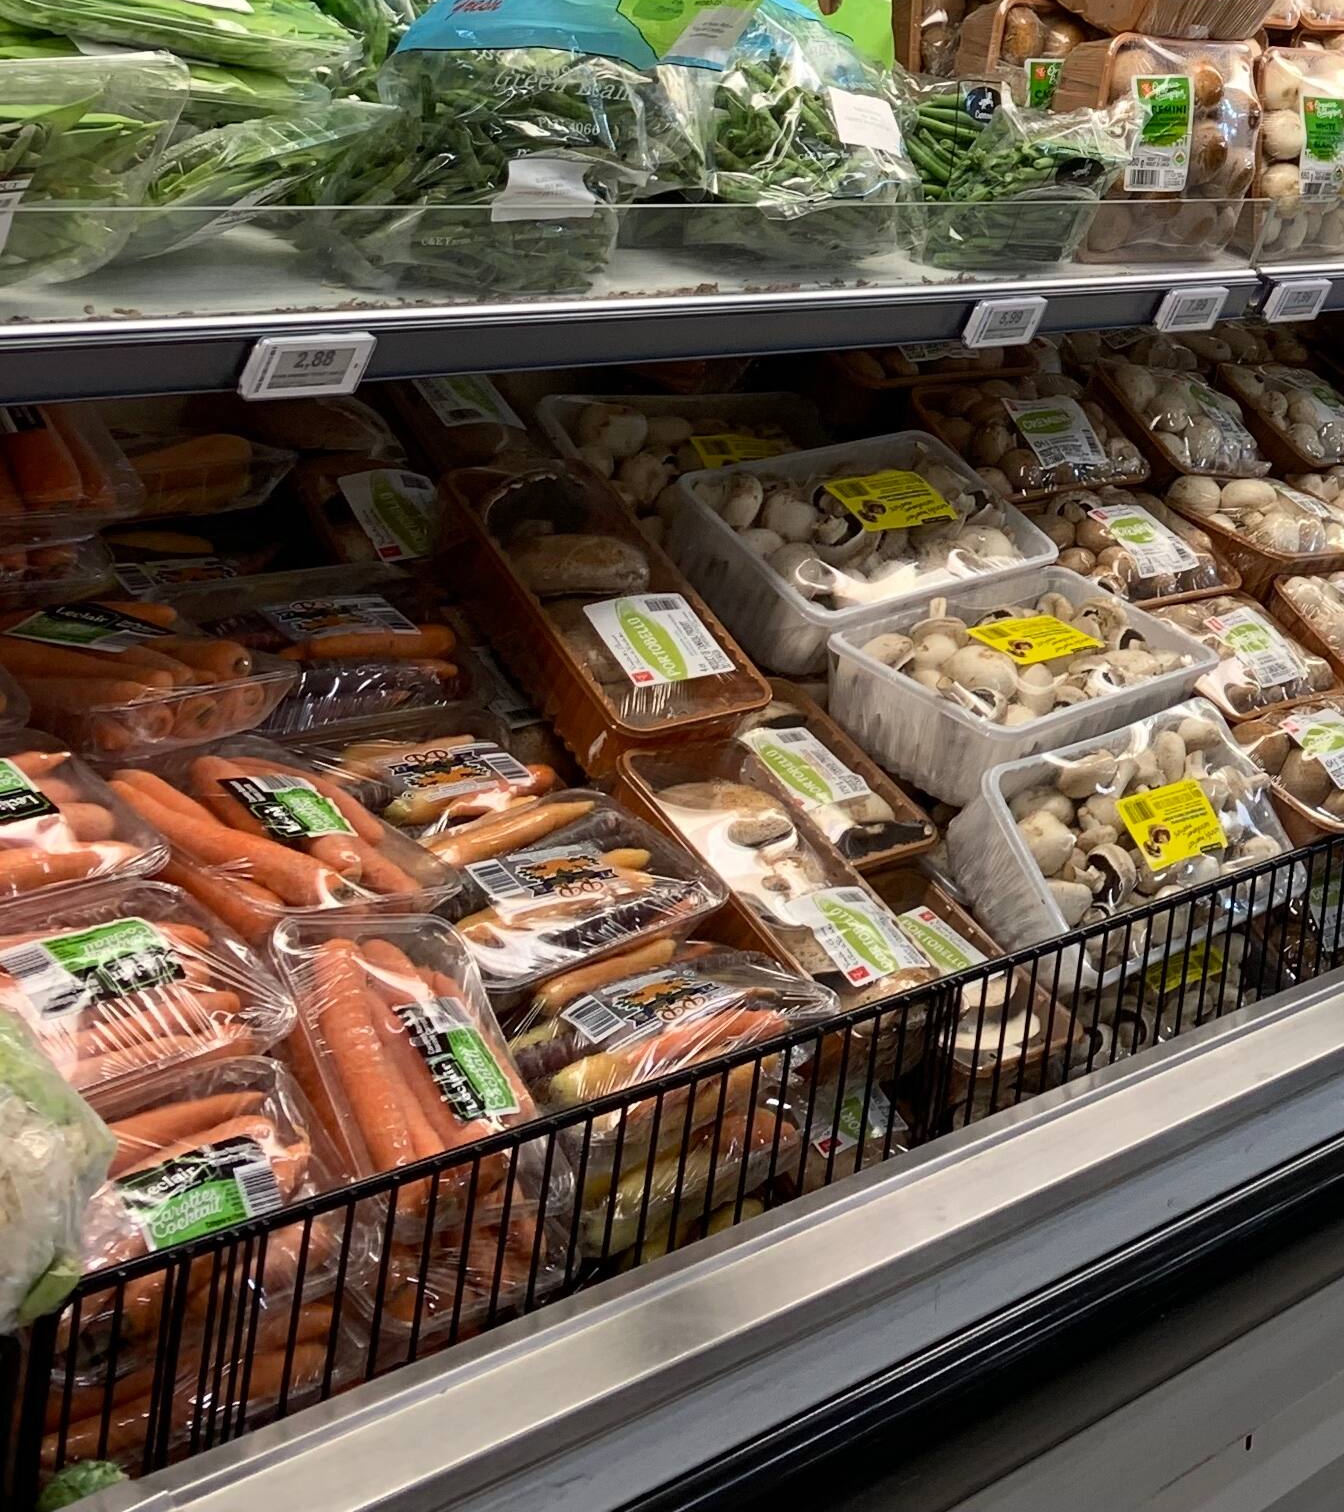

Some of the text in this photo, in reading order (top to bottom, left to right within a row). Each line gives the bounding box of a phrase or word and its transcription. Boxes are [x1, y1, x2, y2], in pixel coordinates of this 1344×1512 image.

[1150, 104, 1187, 115] REMINI
[293, 350, 336, 369] 2,88
[55, 605, 109, 623] Leclair
[626, 616, 683, 677] PORTOBELLO
[765, 749, 830, 803] ORTOBELLO
[901, 918, 968, 969] PORTOBELLO
[441, 1062, 478, 1111] Leclair
[151, 1199, 224, 1238] Cocktail
